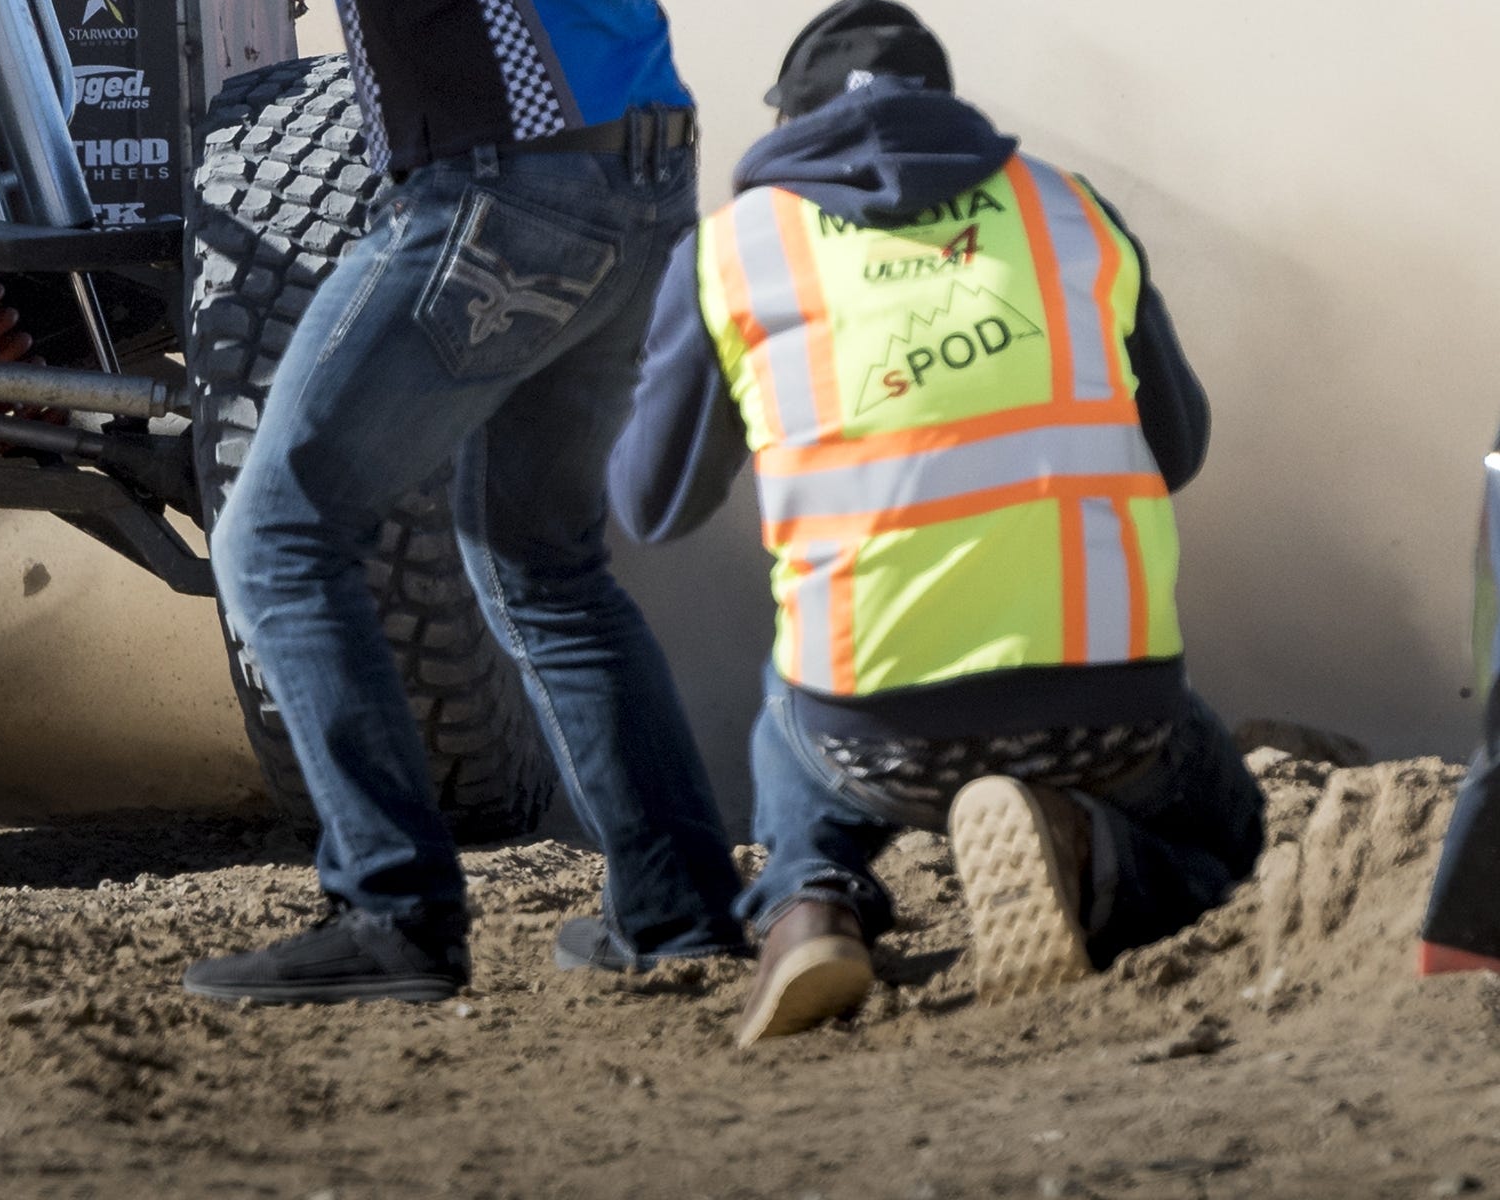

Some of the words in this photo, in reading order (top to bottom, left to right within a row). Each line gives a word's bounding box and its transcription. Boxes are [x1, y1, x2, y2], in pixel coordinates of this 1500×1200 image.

[68, 26, 139, 42] STARWOOD
[99, 97, 150, 111] radios
[882, 314, 1013, 398] sPOD
